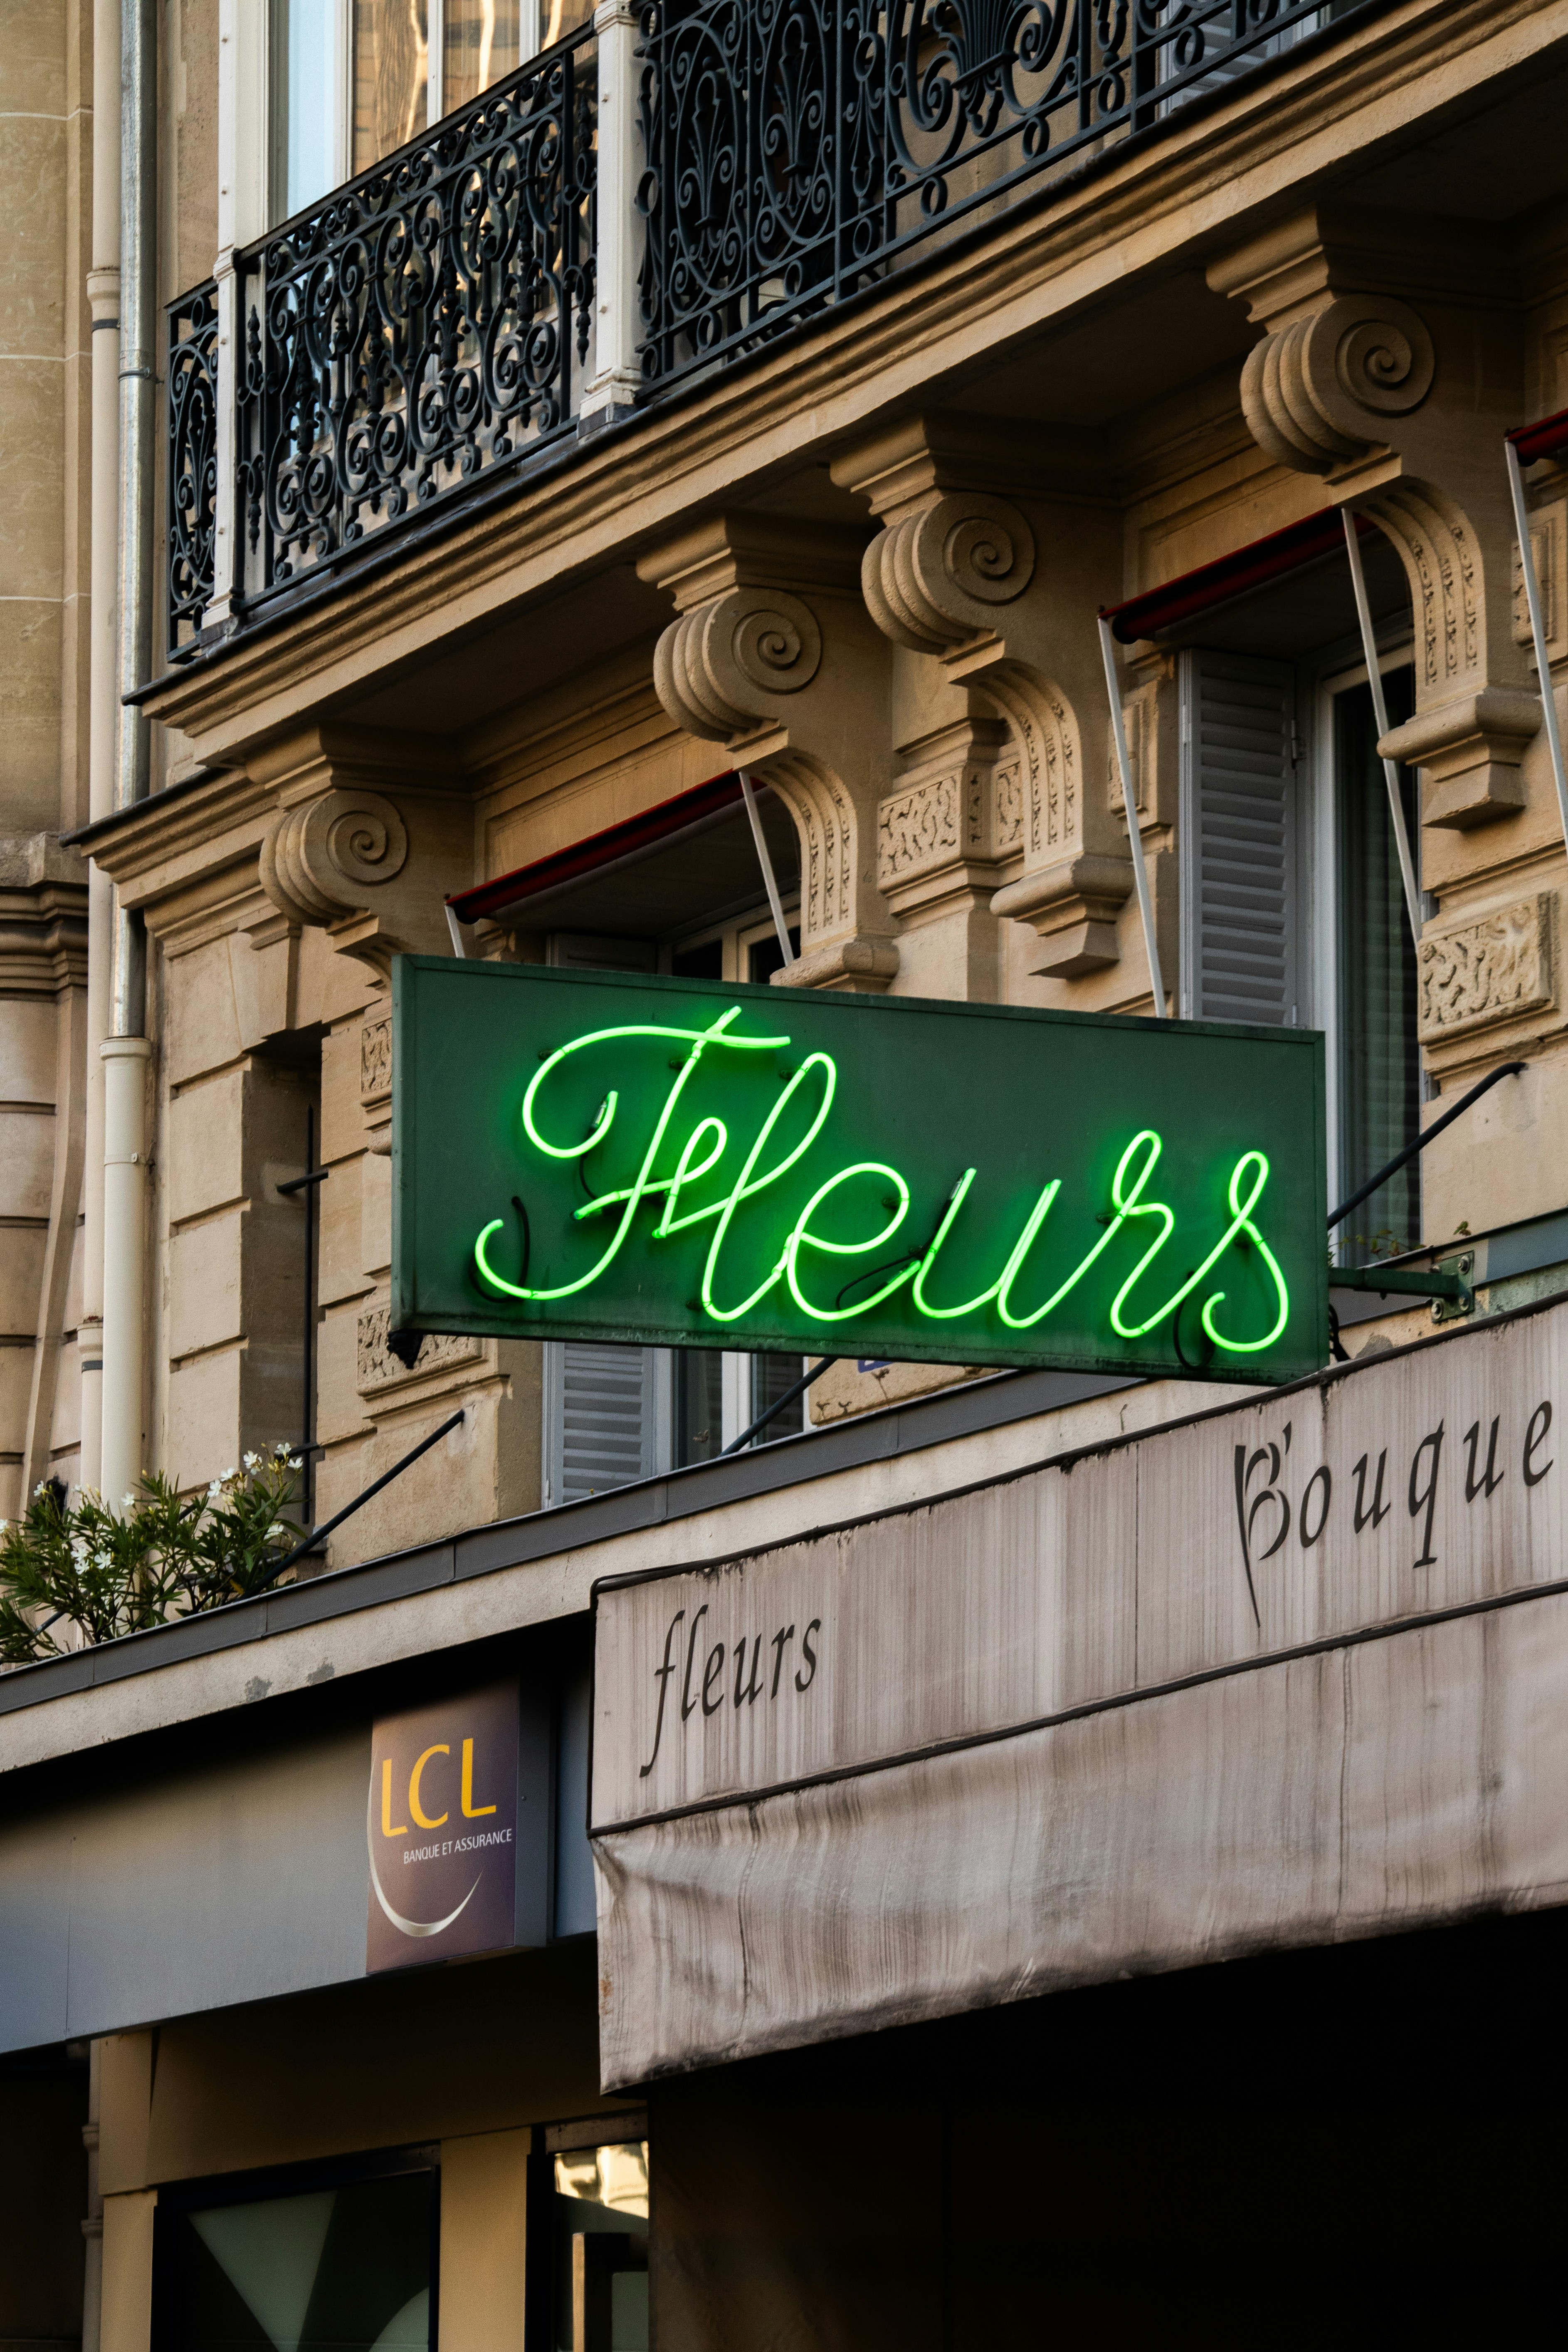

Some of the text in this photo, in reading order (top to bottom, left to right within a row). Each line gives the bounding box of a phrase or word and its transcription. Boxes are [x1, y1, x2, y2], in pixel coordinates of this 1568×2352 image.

[475, 1006, 1289, 1352] Fleurs
[639, 1604, 822, 1778] fleurs
[381, 1737, 496, 1837] LCL
[403, 1828, 512, 1865] BANQUE ET ASSURANCE
